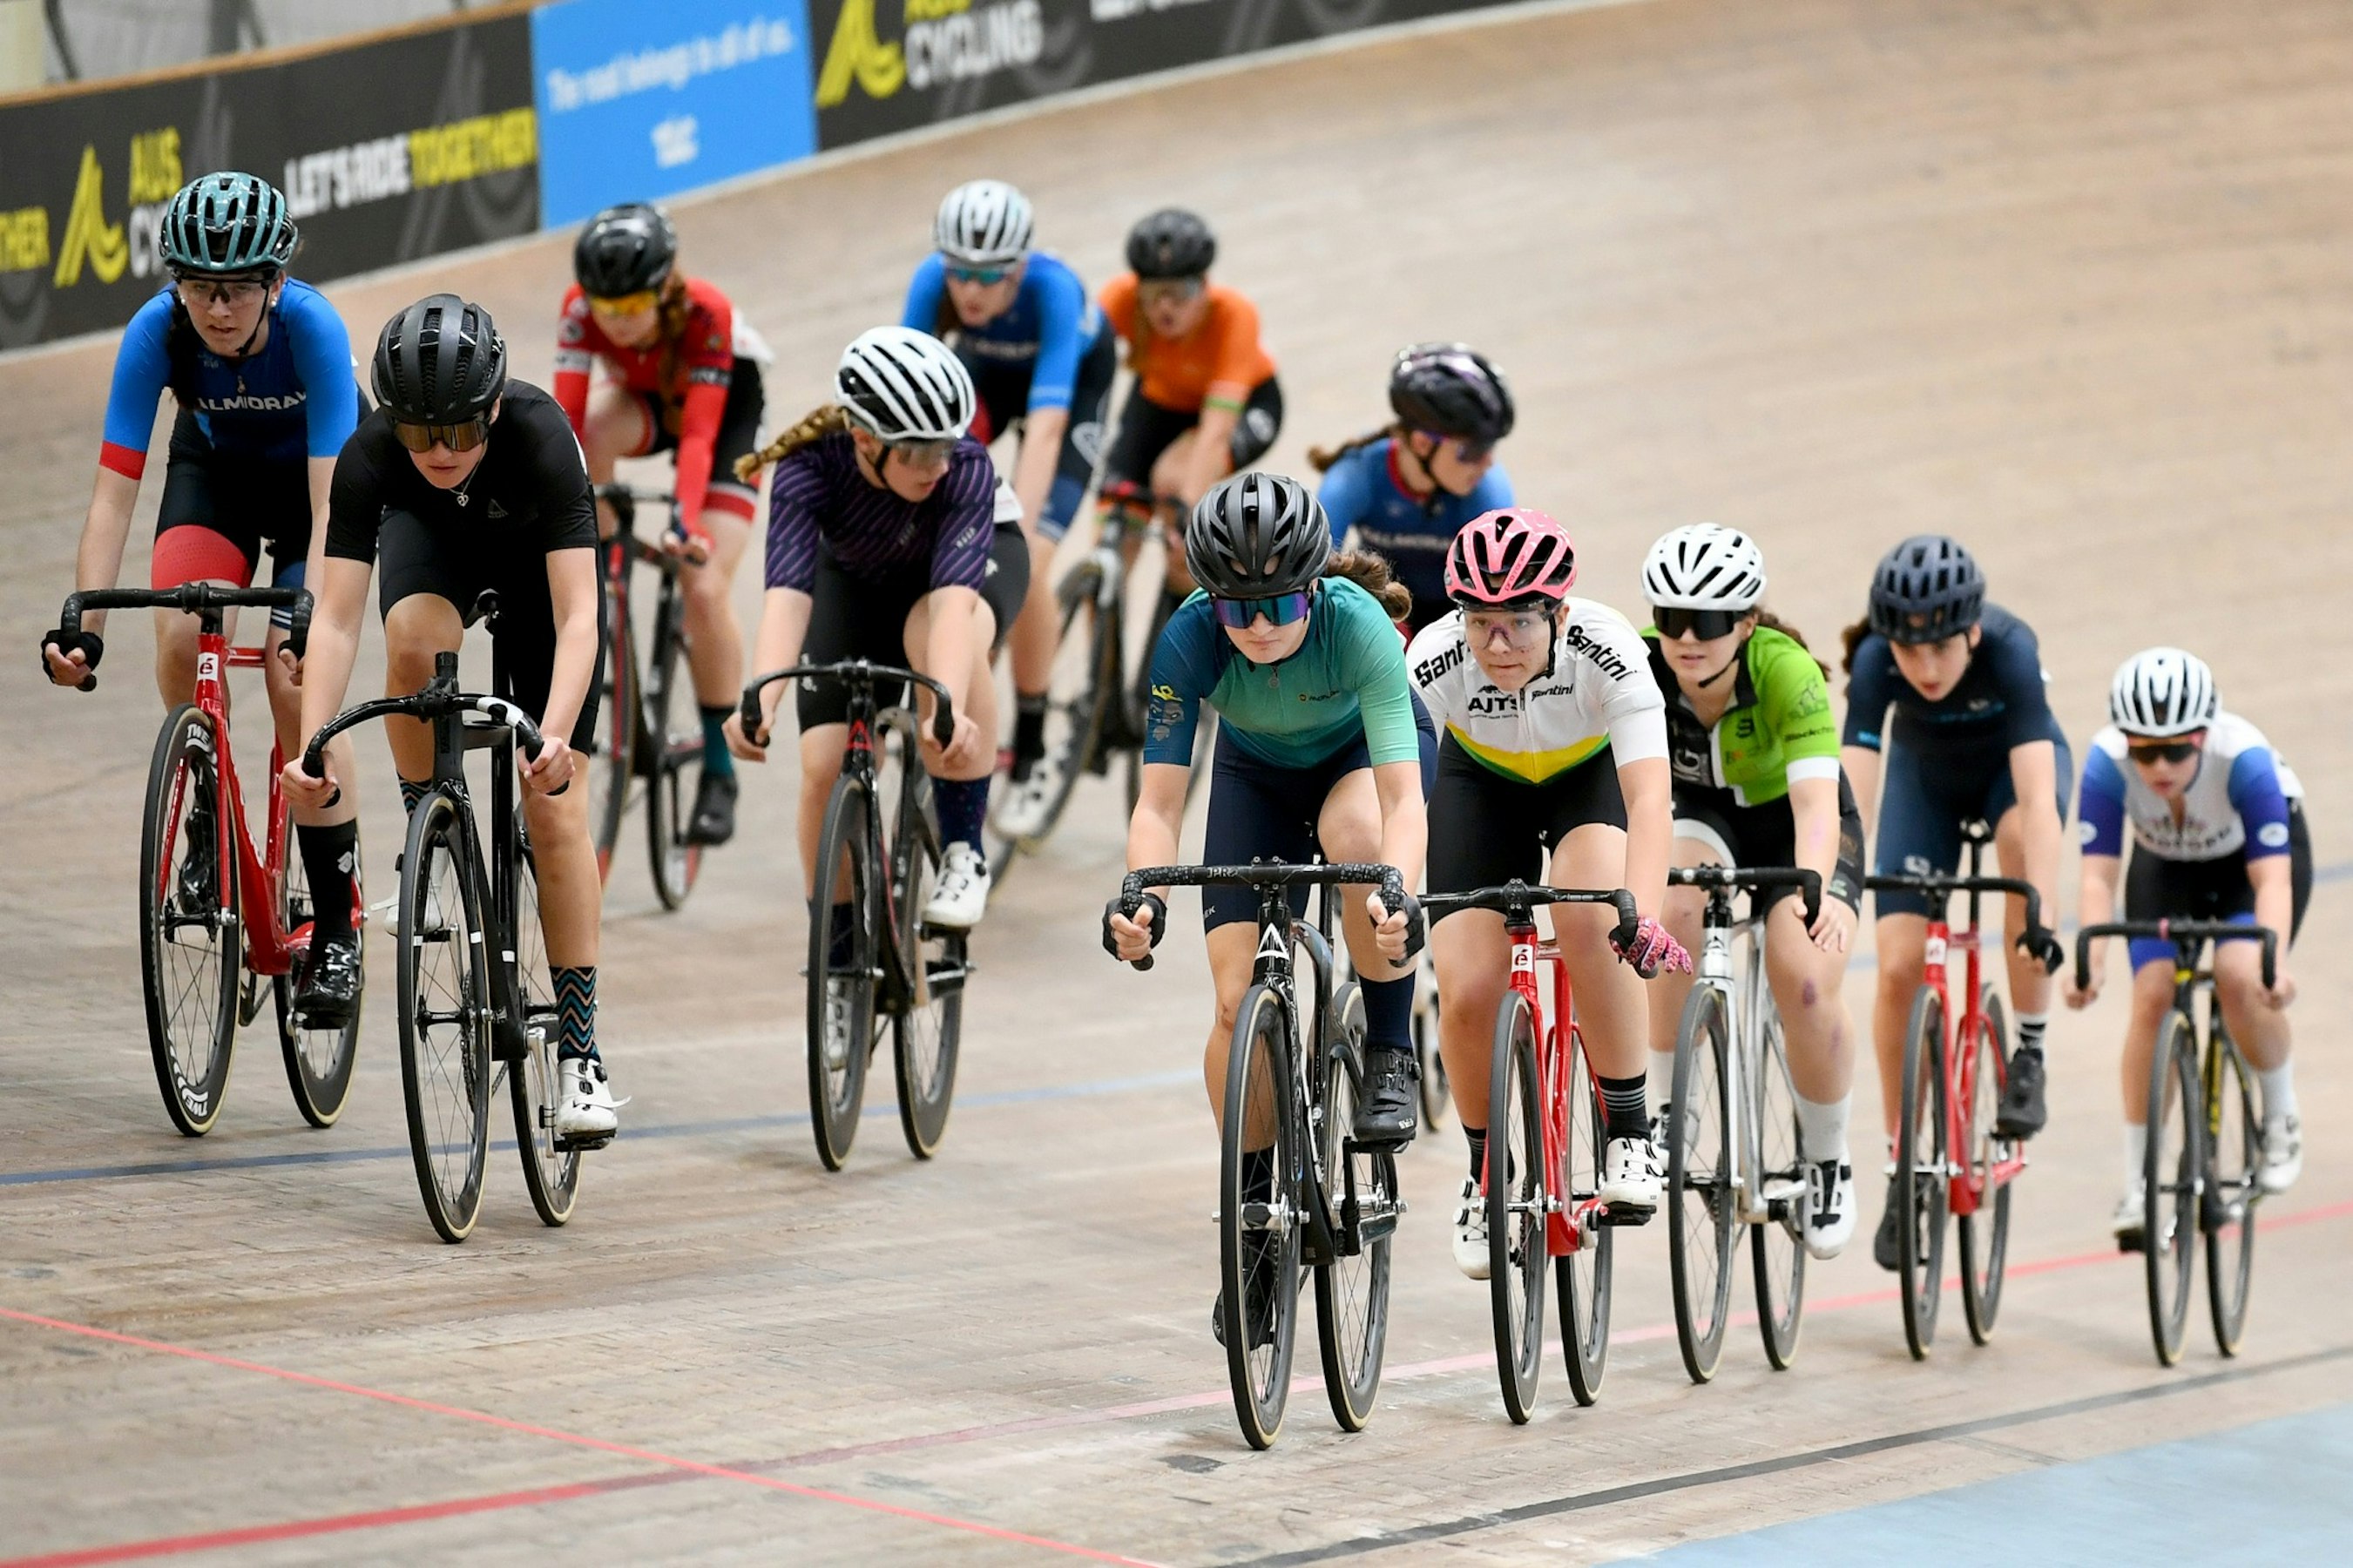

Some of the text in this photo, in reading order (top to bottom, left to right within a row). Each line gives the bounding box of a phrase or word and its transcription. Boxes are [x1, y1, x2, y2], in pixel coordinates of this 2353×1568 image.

[905, 0, 1043, 89] CYCLING
[130, 127, 182, 206] AUS
[1414, 639, 1470, 688] Sant
[1567, 625, 1637, 681] Santini
